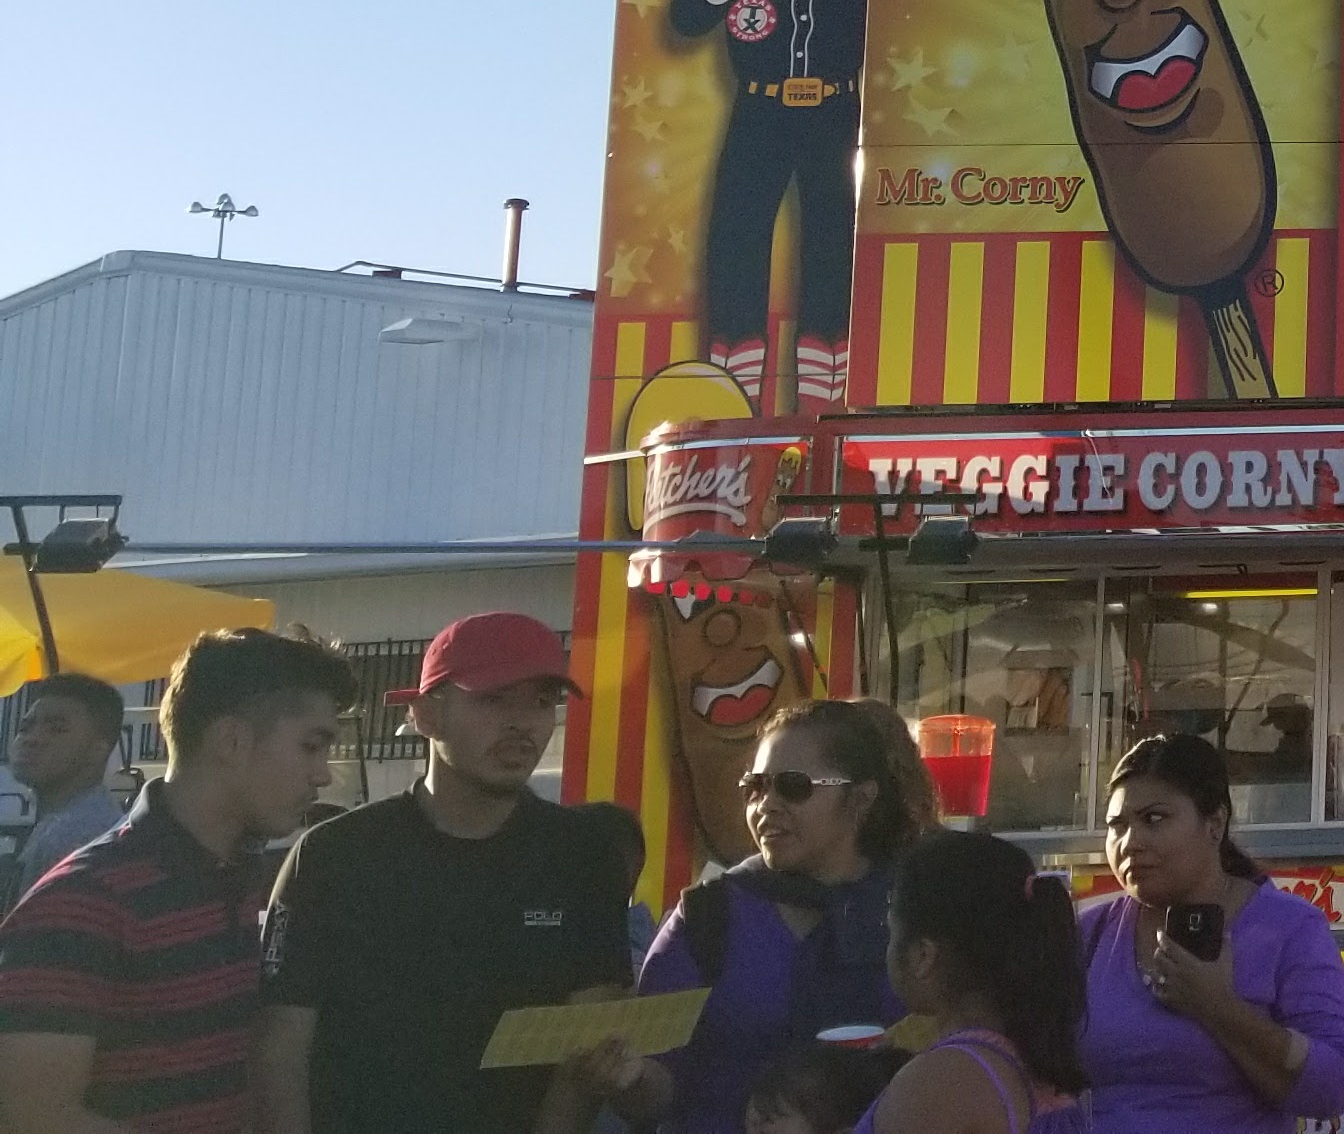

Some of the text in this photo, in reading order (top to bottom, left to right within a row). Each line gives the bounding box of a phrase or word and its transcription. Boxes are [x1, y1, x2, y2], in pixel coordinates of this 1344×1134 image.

[876, 167, 1085, 213] Mr. Corny
[869, 453, 1125, 516] VEGGIE
